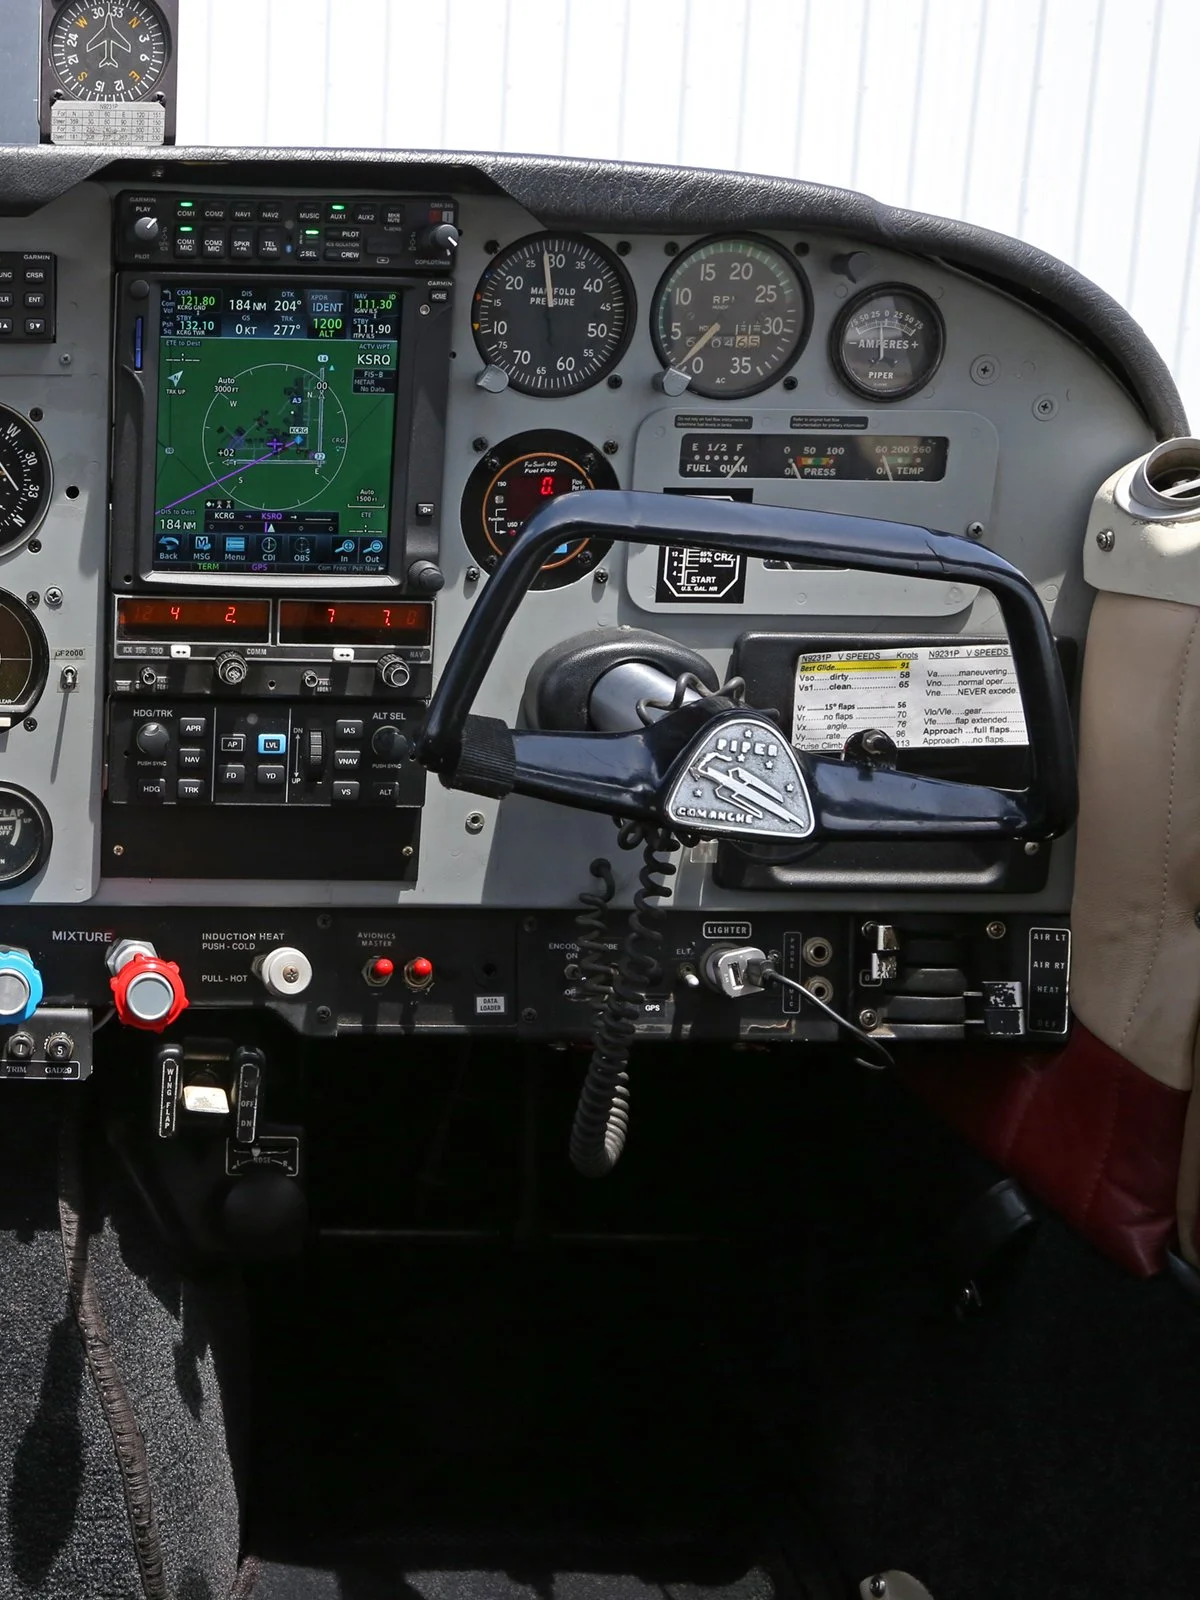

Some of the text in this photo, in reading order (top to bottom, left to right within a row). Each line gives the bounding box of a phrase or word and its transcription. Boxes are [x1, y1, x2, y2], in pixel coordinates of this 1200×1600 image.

[92, 7, 104, 19] 30
[112, 6, 124, 18] 33
[700, 263, 716, 281] 15
[729, 262, 753, 280] 20
[505, 276, 523, 290] 20
[583, 278, 603, 292] 40
[676, 287, 692, 305] 10
[755, 285, 777, 303] 25
[182, 296, 215, 306] 121.80
[230, 300, 250, 310] 184
[358, 300, 392, 309] 111.30
[312, 303, 344, 312] IDENT
[180, 321, 214, 330] 132.10
[313, 318, 342, 329] 1200
[357, 324, 391, 334] 111.90
[858, 339, 909, 349] AMPERES
[357, 354, 392, 365] KSRQ
[557, 356, 575, 370] 60
[686, 464, 748, 473] FUEL QUAN
[804, 468, 836, 477] PRESS
[897, 467, 924, 476] TEMP
[160, 520, 181, 529] 184
[714, 553, 736, 562] CRZ.
[802, 654, 832, 662] N9231P
[929, 650, 959, 658] N9231P
[974, 648, 1009, 656] SPEEDS
[133, 710, 173, 718] HDG/TRK
[716, 738, 778, 756] PIPER
[677, 807, 754, 824] COMANCHE
[708, 926, 747, 934] LIGHTER
[52, 931, 113, 943] MIXTURE
[202, 932, 285, 941] INDUCTION HEAT
[7, 1065, 27, 1074] TRIM
[166, 1069, 174, 1096] WING
